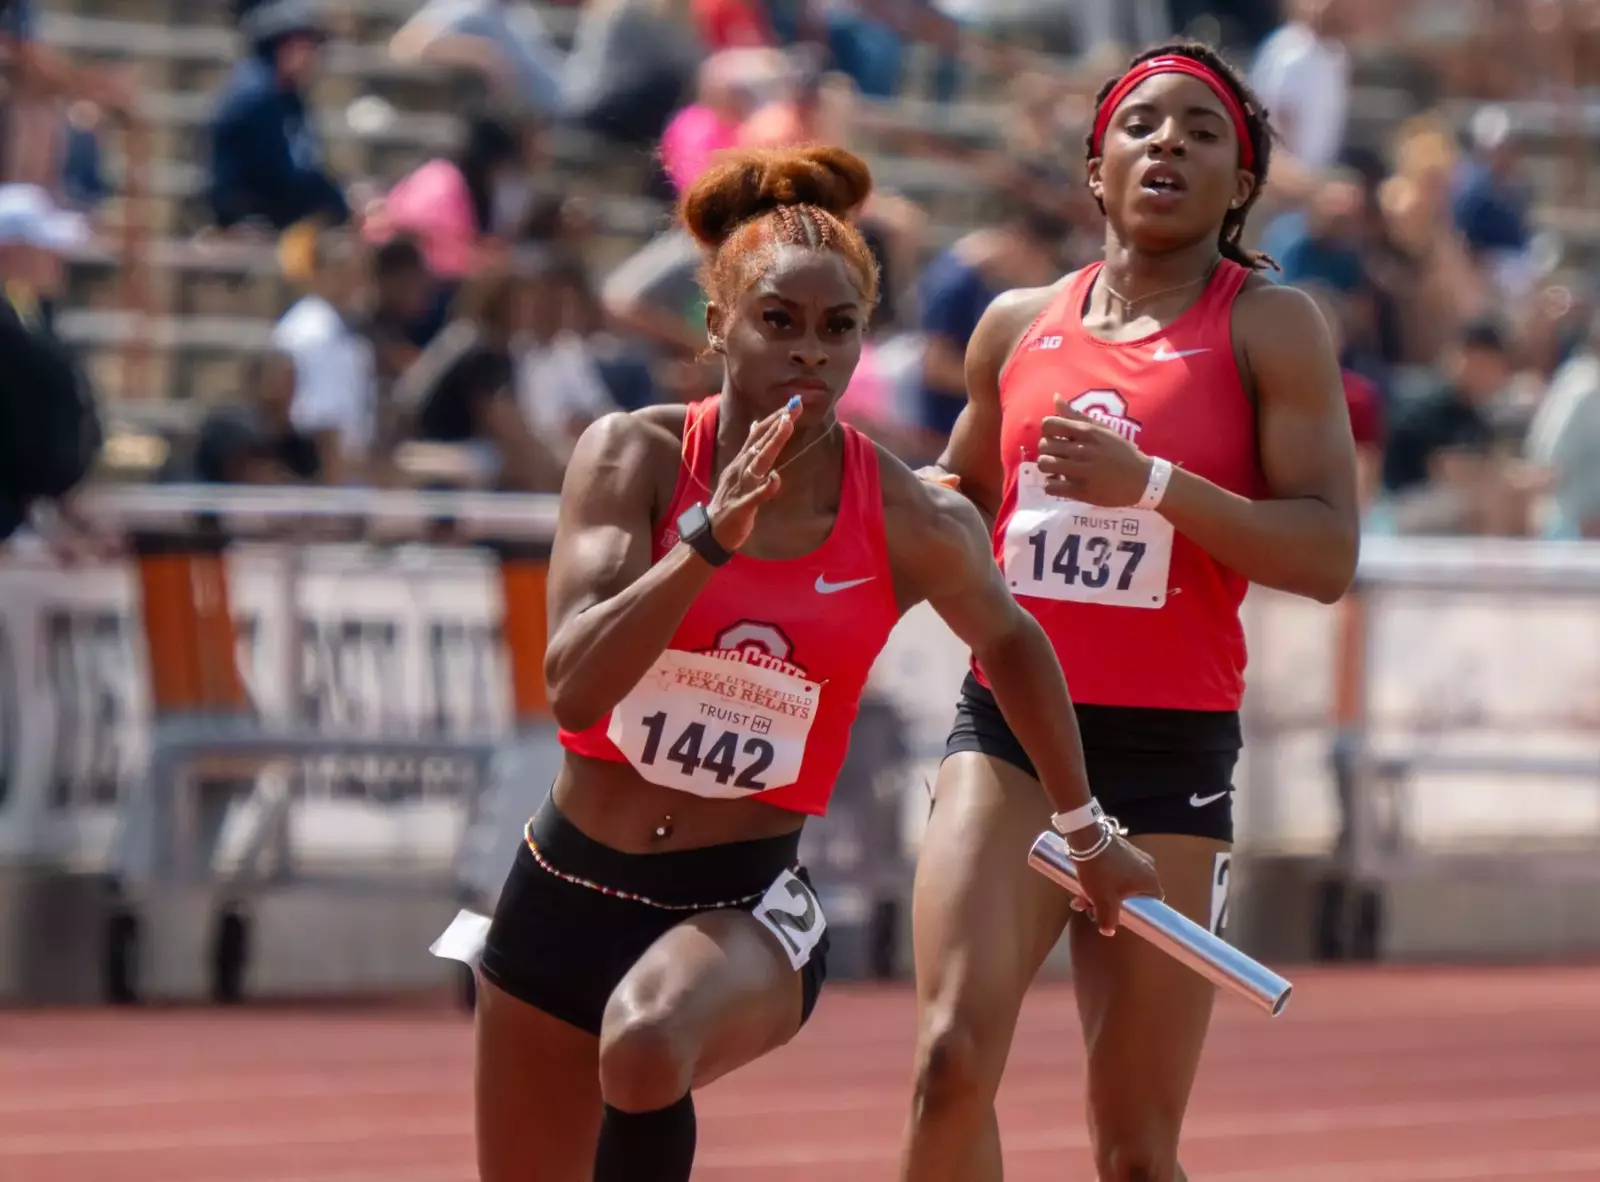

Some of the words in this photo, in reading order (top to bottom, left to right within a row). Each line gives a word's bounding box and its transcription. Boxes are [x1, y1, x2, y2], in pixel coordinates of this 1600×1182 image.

[1073, 515, 1119, 531] TRUIST
[1029, 530, 1147, 591] 1437
[675, 672, 737, 698] TEXAS
[741, 687, 811, 720] RELAYS
[677, 667, 721, 681] CLYDE
[725, 674, 813, 707] LITTLEFIELD
[699, 702, 751, 727] TRUIST
[640, 710, 775, 791] 1442
[764, 878, 816, 957] 2
